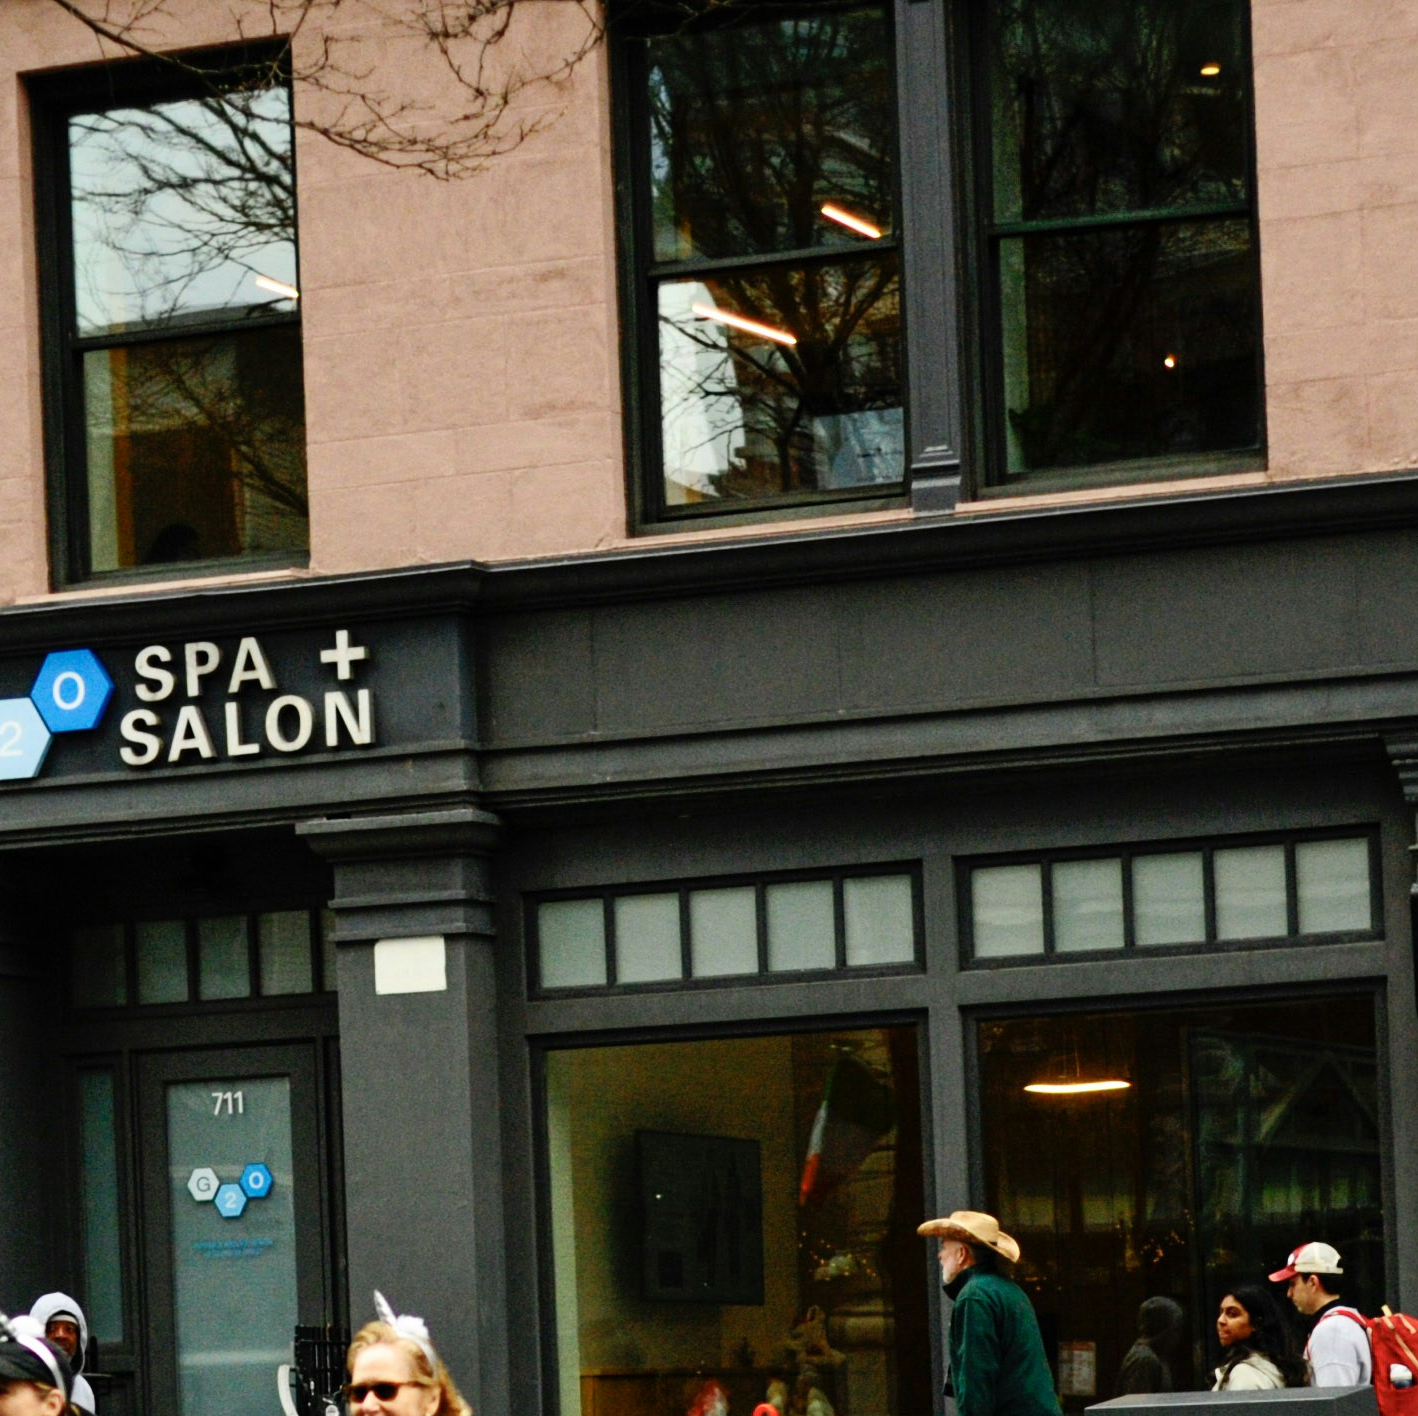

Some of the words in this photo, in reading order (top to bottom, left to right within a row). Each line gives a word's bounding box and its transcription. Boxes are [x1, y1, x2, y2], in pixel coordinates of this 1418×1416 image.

[134, 637, 275, 702] SPA
[119, 689, 376, 766] SALON
[212, 1091, 244, 1116] 711
